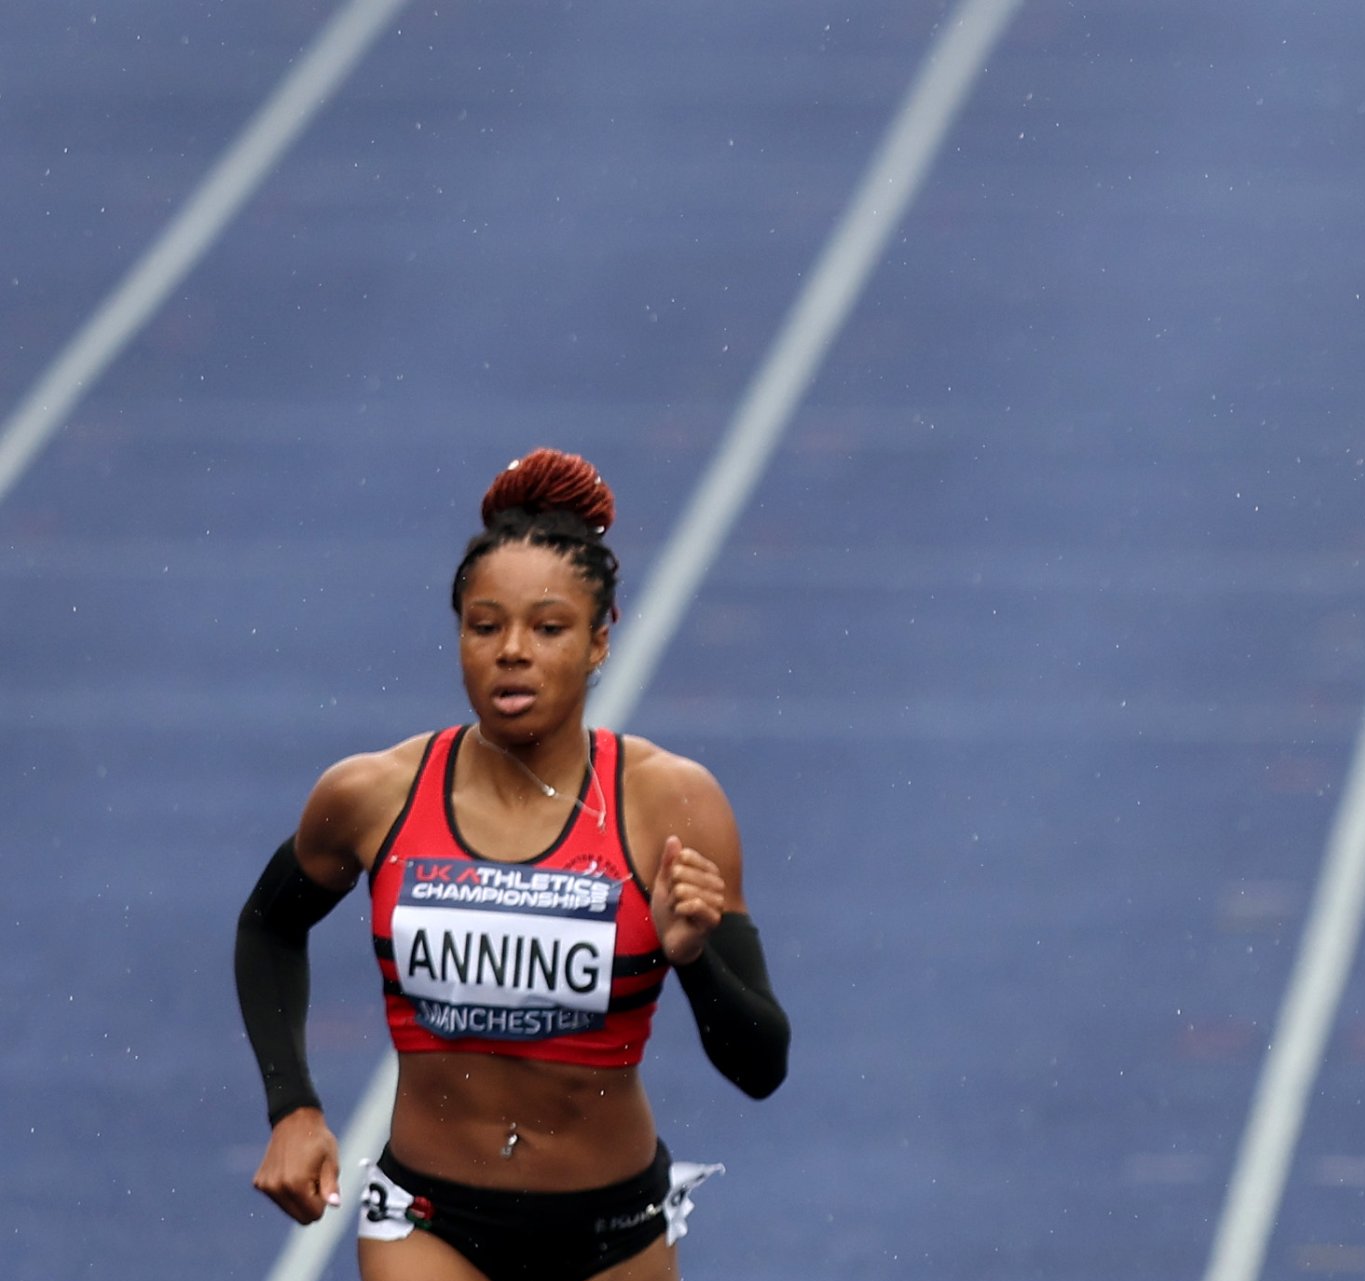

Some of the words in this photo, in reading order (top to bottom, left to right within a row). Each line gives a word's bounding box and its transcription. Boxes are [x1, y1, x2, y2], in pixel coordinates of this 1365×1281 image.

[415, 864, 452, 881] UK
[455, 866, 610, 896] ATHLETICS
[411, 883, 608, 912] CHAMPIONSHIPS
[408, 929, 600, 993] ANNING
